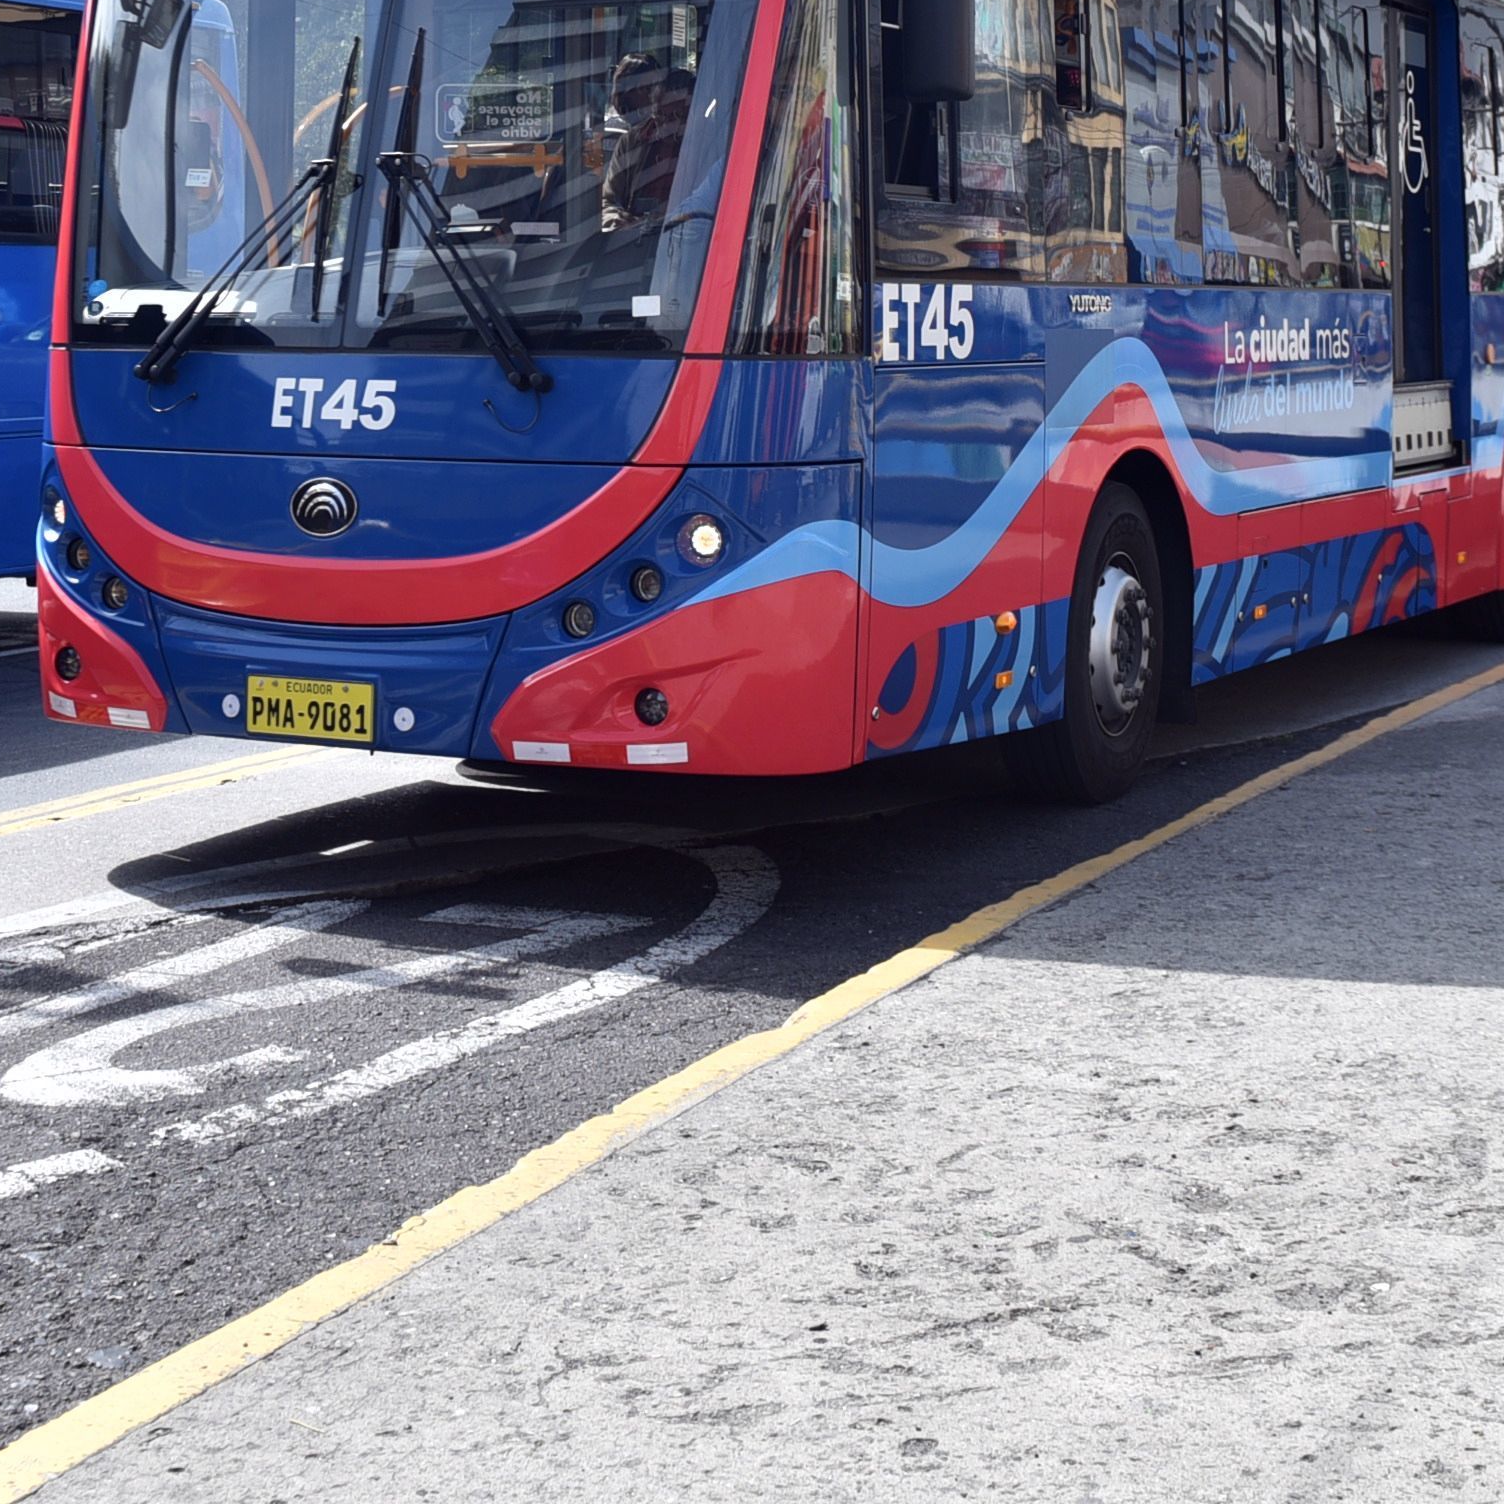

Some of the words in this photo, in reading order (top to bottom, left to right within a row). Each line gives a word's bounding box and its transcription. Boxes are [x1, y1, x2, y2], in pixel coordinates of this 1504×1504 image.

[882, 283, 974, 361] ET45
[1069, 295, 1112, 312] YUTONG
[1224, 321, 1245, 364] La
[1249, 315, 1310, 363] ciudad
[1316, 318, 1350, 360] más
[271, 377, 397, 431] ET45
[1213, 360, 1262, 435] linda
[1264, 369, 1291, 417] del
[1296, 368, 1354, 414] mundo
[286, 681, 333, 695] ECUADOR
[252, 696, 367, 735] PMA-9081
